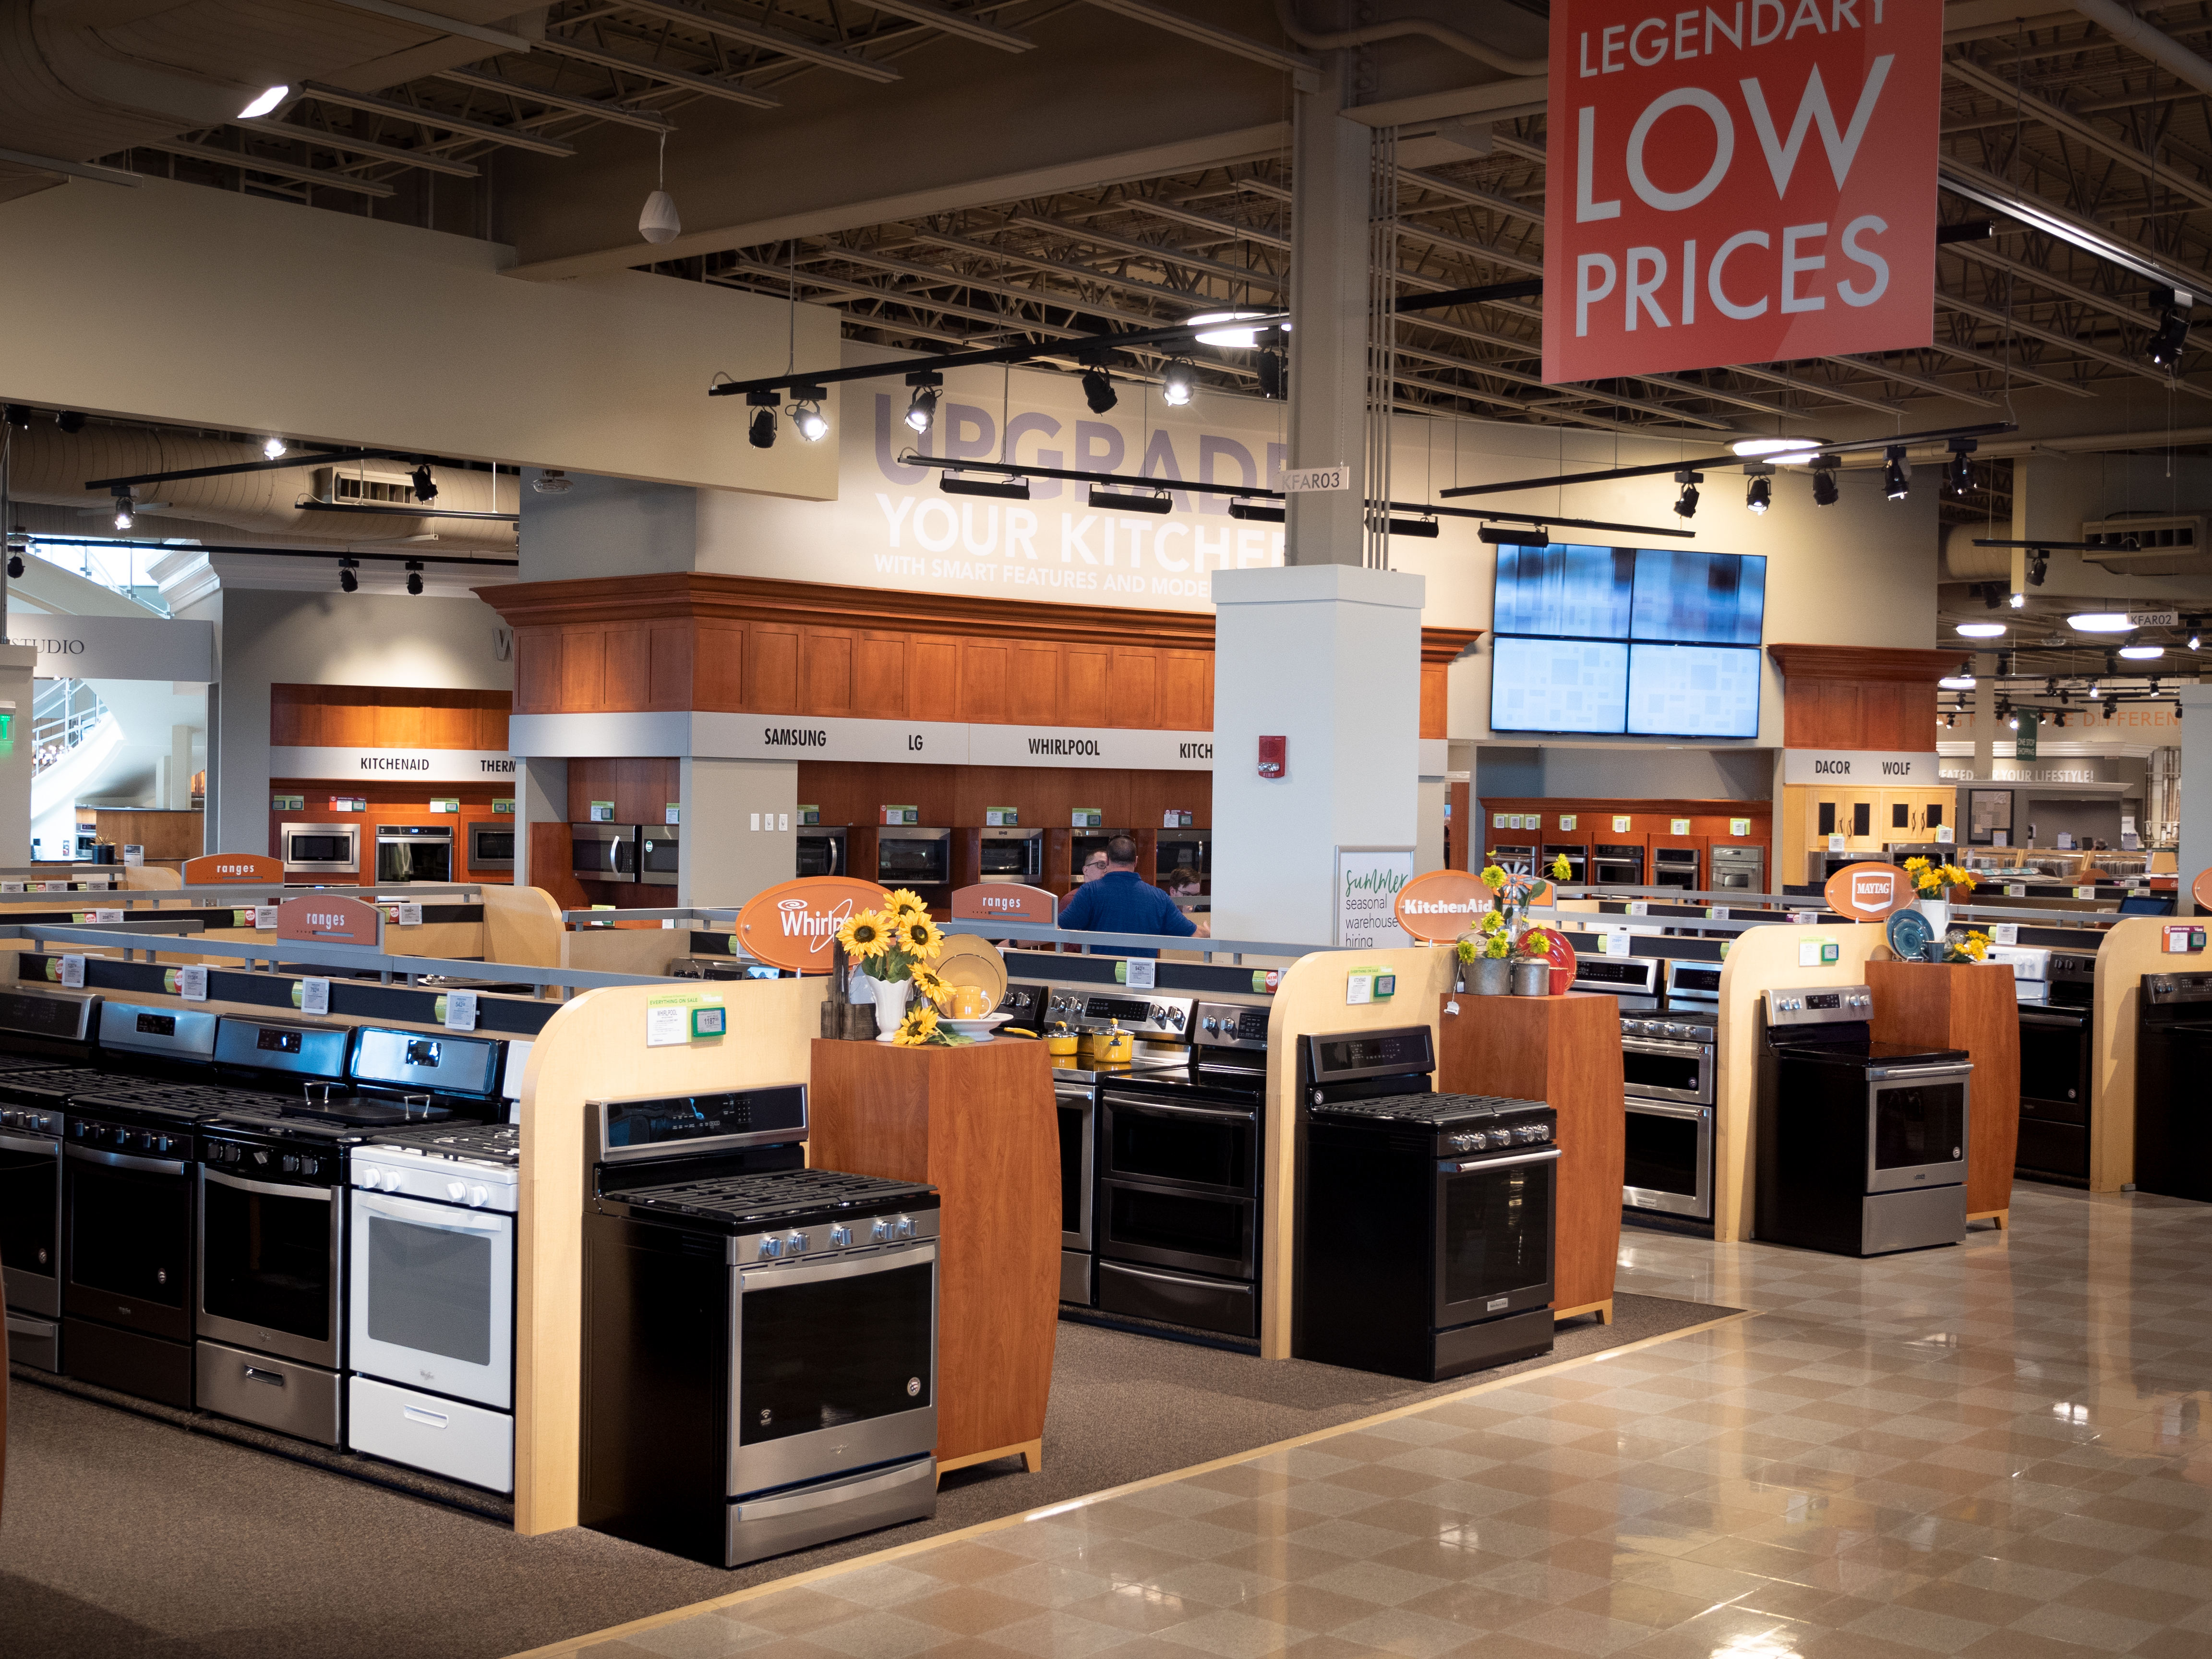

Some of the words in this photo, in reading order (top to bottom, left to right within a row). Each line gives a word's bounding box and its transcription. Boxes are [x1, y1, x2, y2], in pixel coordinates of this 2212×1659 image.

[1579, 0, 1886, 78] LEGENDARY
[1576, 54, 1895, 224] LOW
[1575, 215, 1889, 337] PRICES
[1282, 472, 1339, 490] KFAR03
[875, 493, 1039, 559] YOUR
[874, 554, 924, 577] WITH
[931, 559, 997, 583] SMART
[1003, 565, 1097, 590] FEATURES
[1103, 575, 1145, 593] AND
[2131, 615, 2171, 625] KFAR02
[765, 728, 827, 747] SAMSUNG
[908, 734, 923, 751] LG
[1028, 738, 1100, 756] WHIRLPOOL
[361, 757, 430, 770] KITCHENAID
[1815, 760, 1851, 774] DACOR
[1882, 761, 1911, 775] WOLF
[2003, 769, 2032, 781] YOUR
[2035, 770, 2094, 783] LIFESTYLE!
[217, 865, 254, 876] ranges
[1857, 883, 1890, 894] MAYTAG
[983, 897, 1021, 911] ranges
[1346, 893, 1387, 910] seasonal
[1405, 899, 1492, 914] KitchenAid
[307, 913, 345, 930] ranges
[1346, 913, 1399, 929] warehouse
[1346, 933, 1373, 948] hiring
